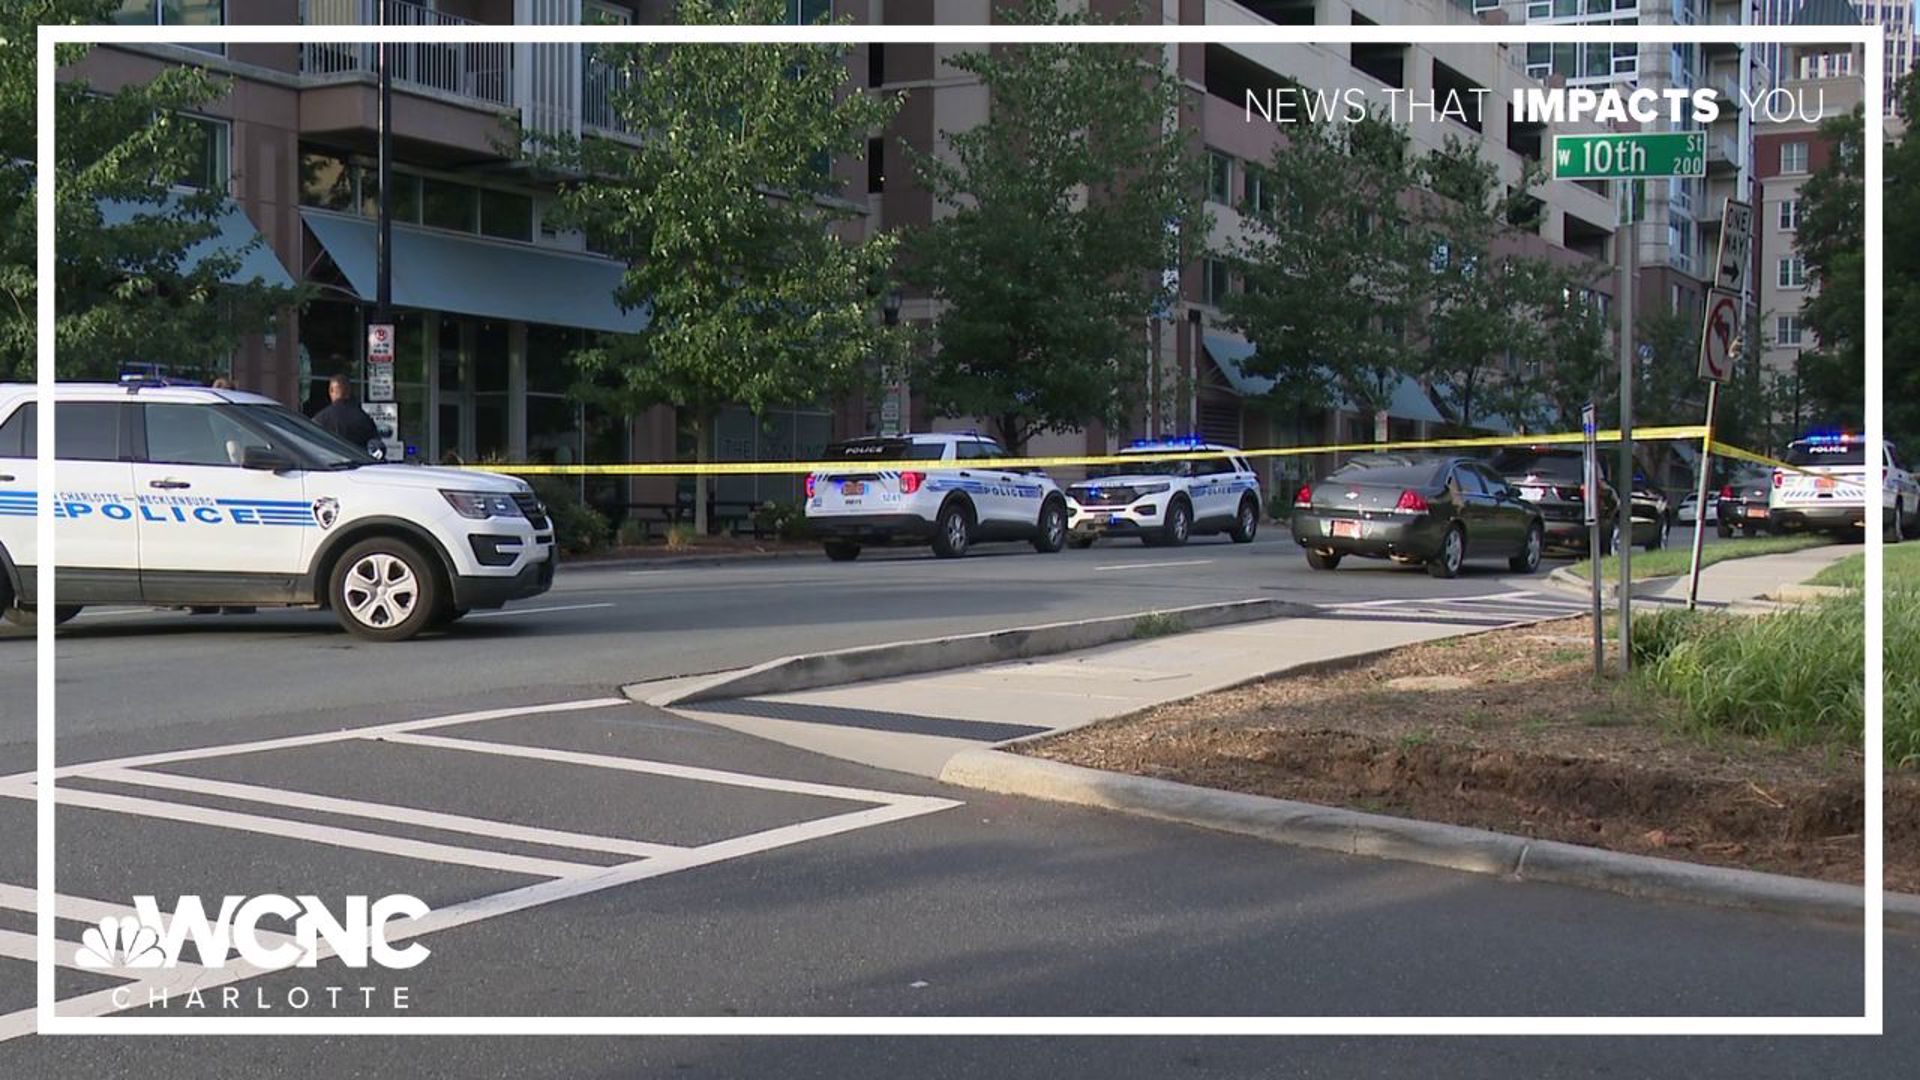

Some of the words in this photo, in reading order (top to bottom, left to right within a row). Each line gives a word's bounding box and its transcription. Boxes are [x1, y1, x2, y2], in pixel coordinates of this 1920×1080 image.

[1687, 135, 1702, 151] St
[1558, 149, 1571, 166] W
[1583, 140, 1646, 172] 10th
[1673, 156, 1701, 174] 200
[1727, 207, 1748, 232] ONE
[1724, 232, 1744, 256] WAY
[845, 446, 884, 454] POLICE
[1809, 446, 1848, 454] POLICE
[59, 491, 121, 504] CHARLOTTE
[137, 494, 214, 507] MECKLENBURG
[983, 486, 1024, 498] POLICE
[64, 502, 260, 525] POLICE
